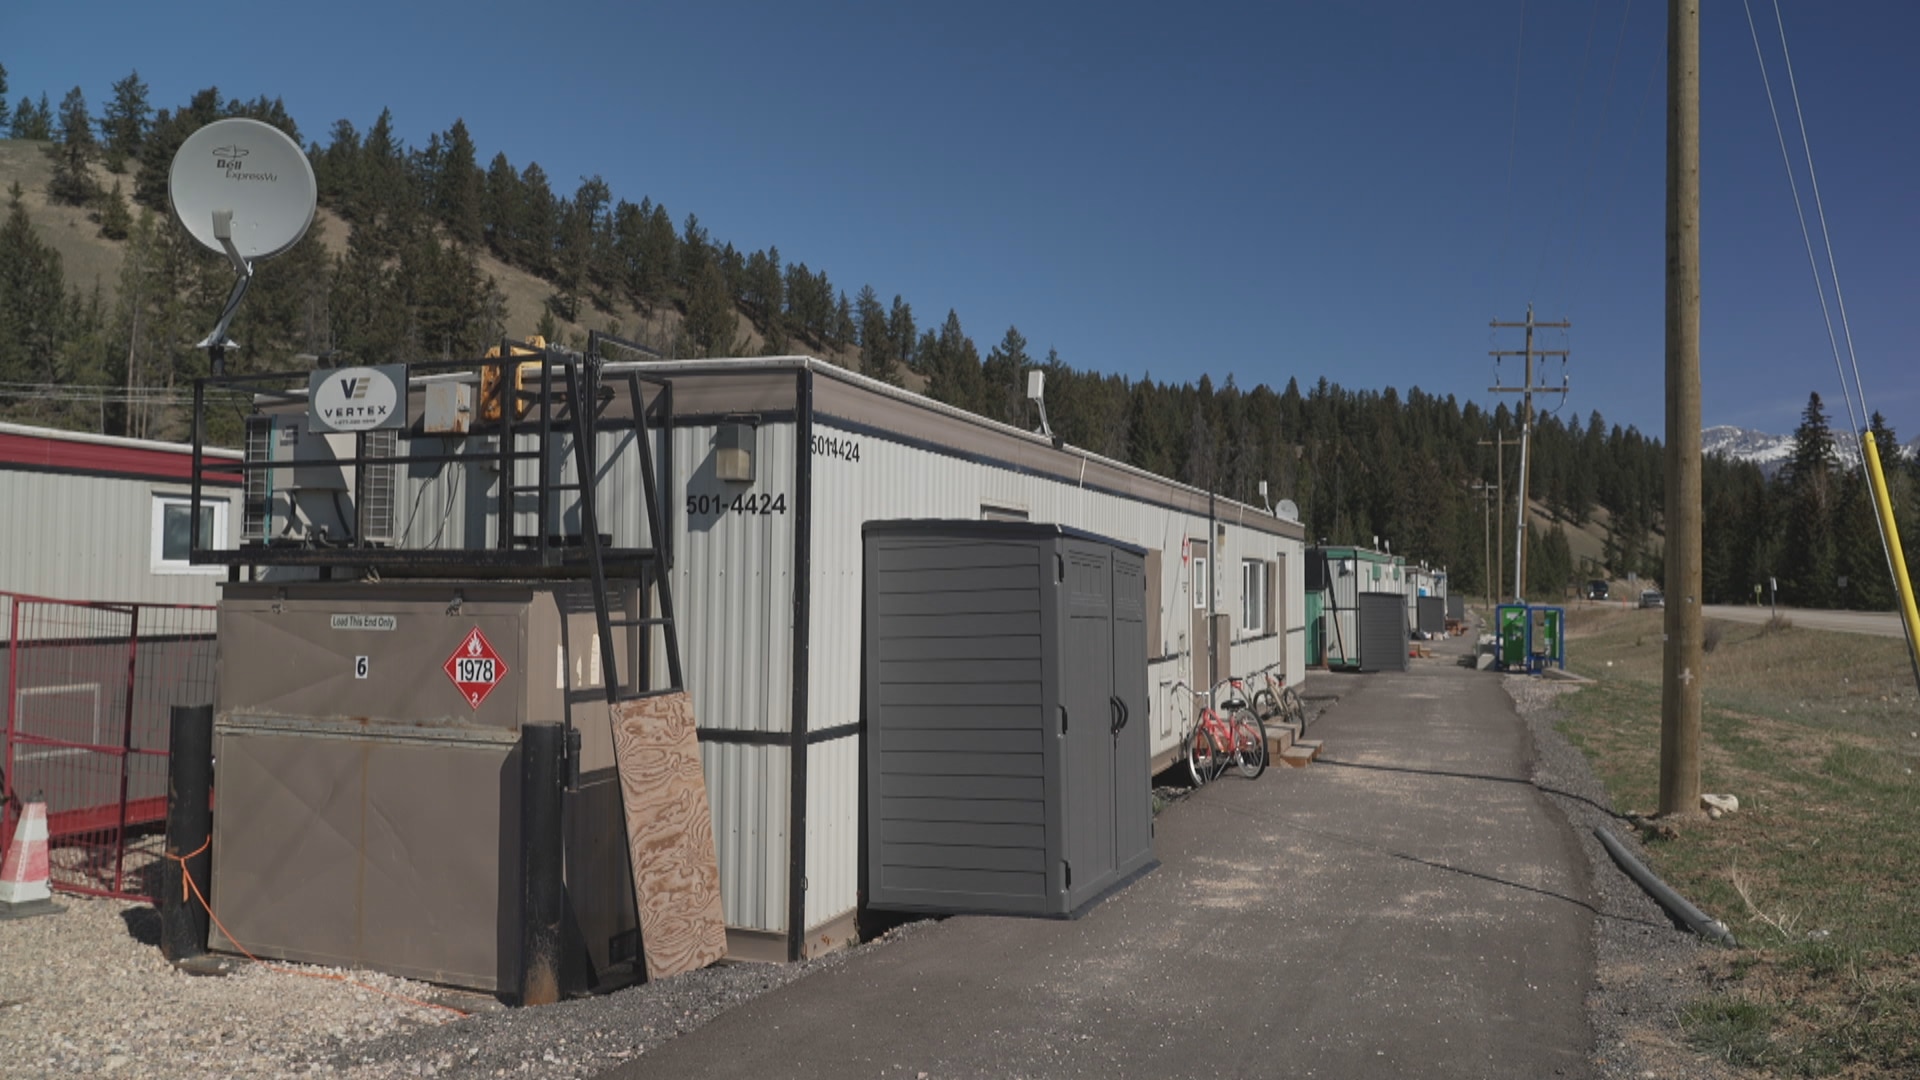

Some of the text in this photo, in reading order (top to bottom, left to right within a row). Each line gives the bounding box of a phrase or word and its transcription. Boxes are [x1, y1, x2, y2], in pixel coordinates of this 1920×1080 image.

[217, 159, 242, 170] Bell
[225, 170, 277, 182] ExpressVu
[324, 405, 387, 418] VERTEX
[686, 493, 787, 515] 501-4424
[333, 616, 394, 630] Load This End Only
[357, 658, 367, 676] 6
[458, 659, 493, 682] 1978
[472, 692, 479, 703] 2
